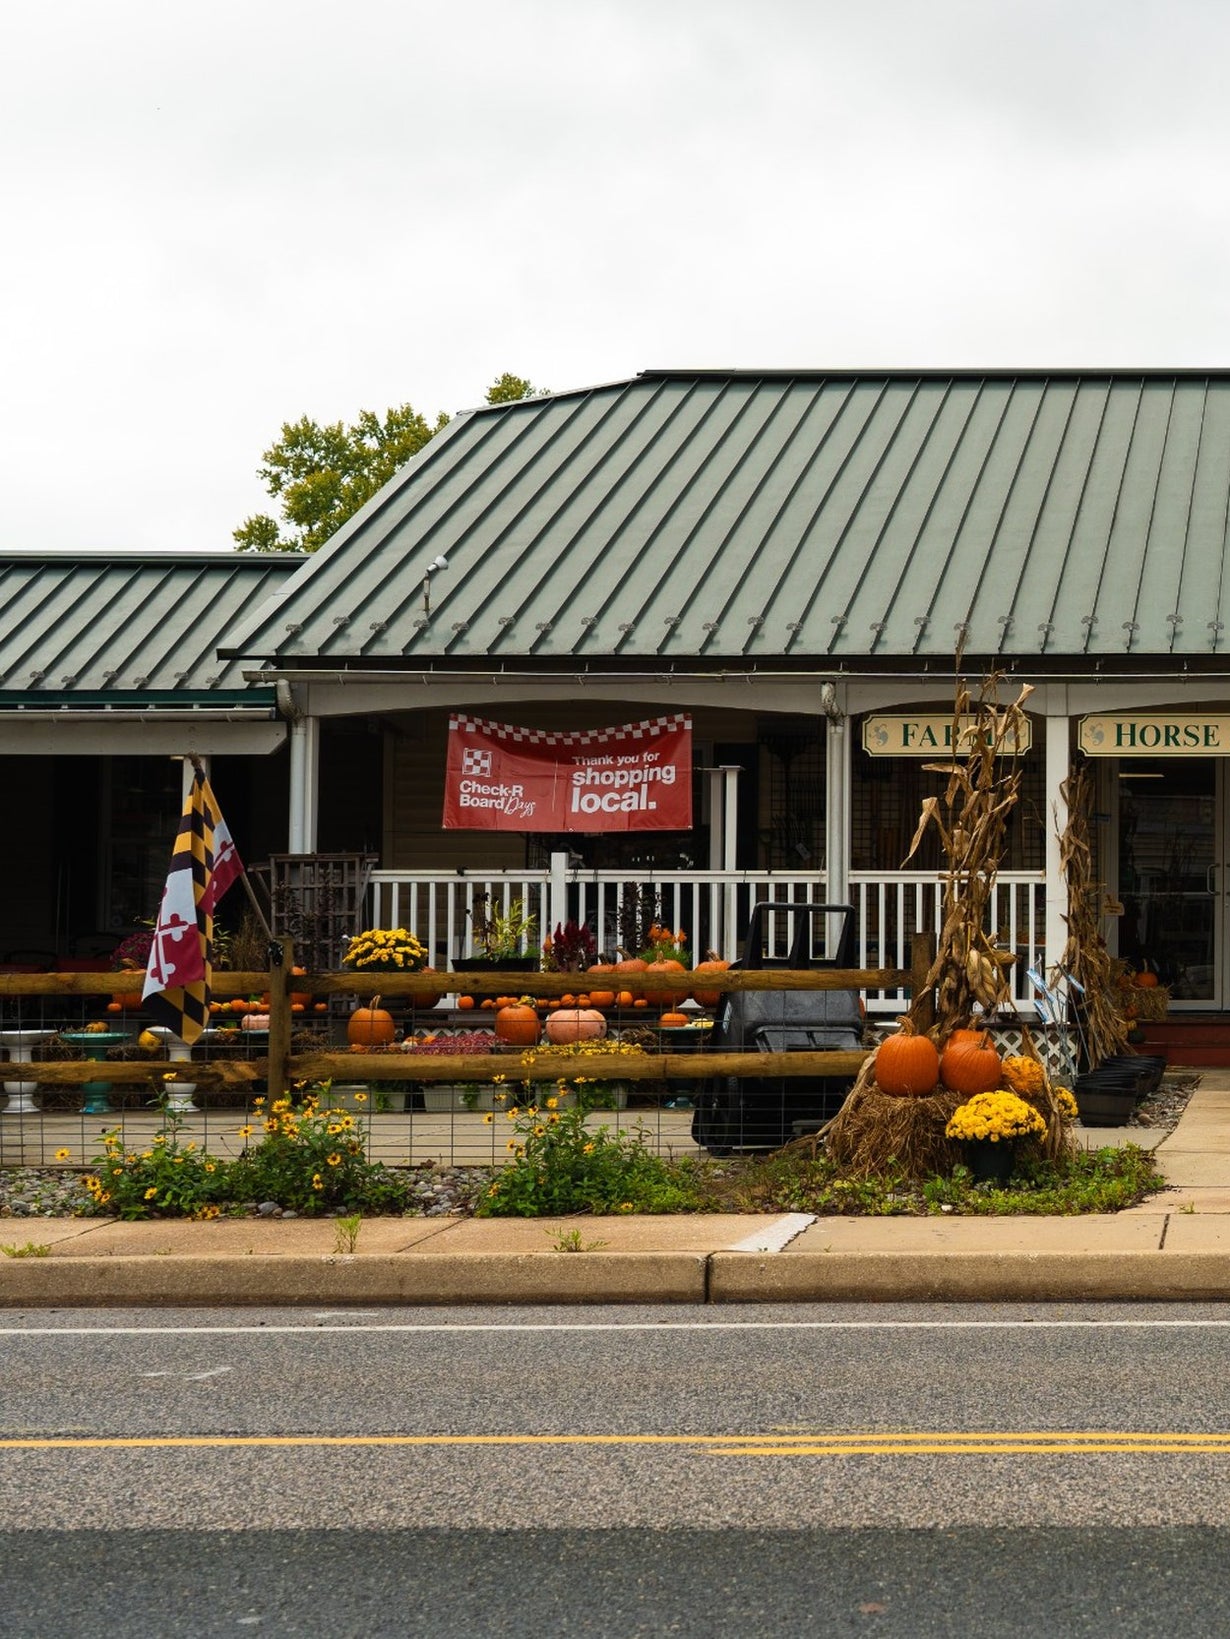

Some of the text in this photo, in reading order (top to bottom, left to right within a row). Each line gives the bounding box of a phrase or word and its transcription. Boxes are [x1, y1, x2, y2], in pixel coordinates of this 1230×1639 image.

[1114, 722, 1220, 747] HORSE
[572, 751, 661, 767] Thank you for
[572, 764, 677, 788] shopping
[459, 780, 524, 797] Check-R
[571, 784, 657, 814] local.
[459, 794, 536, 818] Board Days
